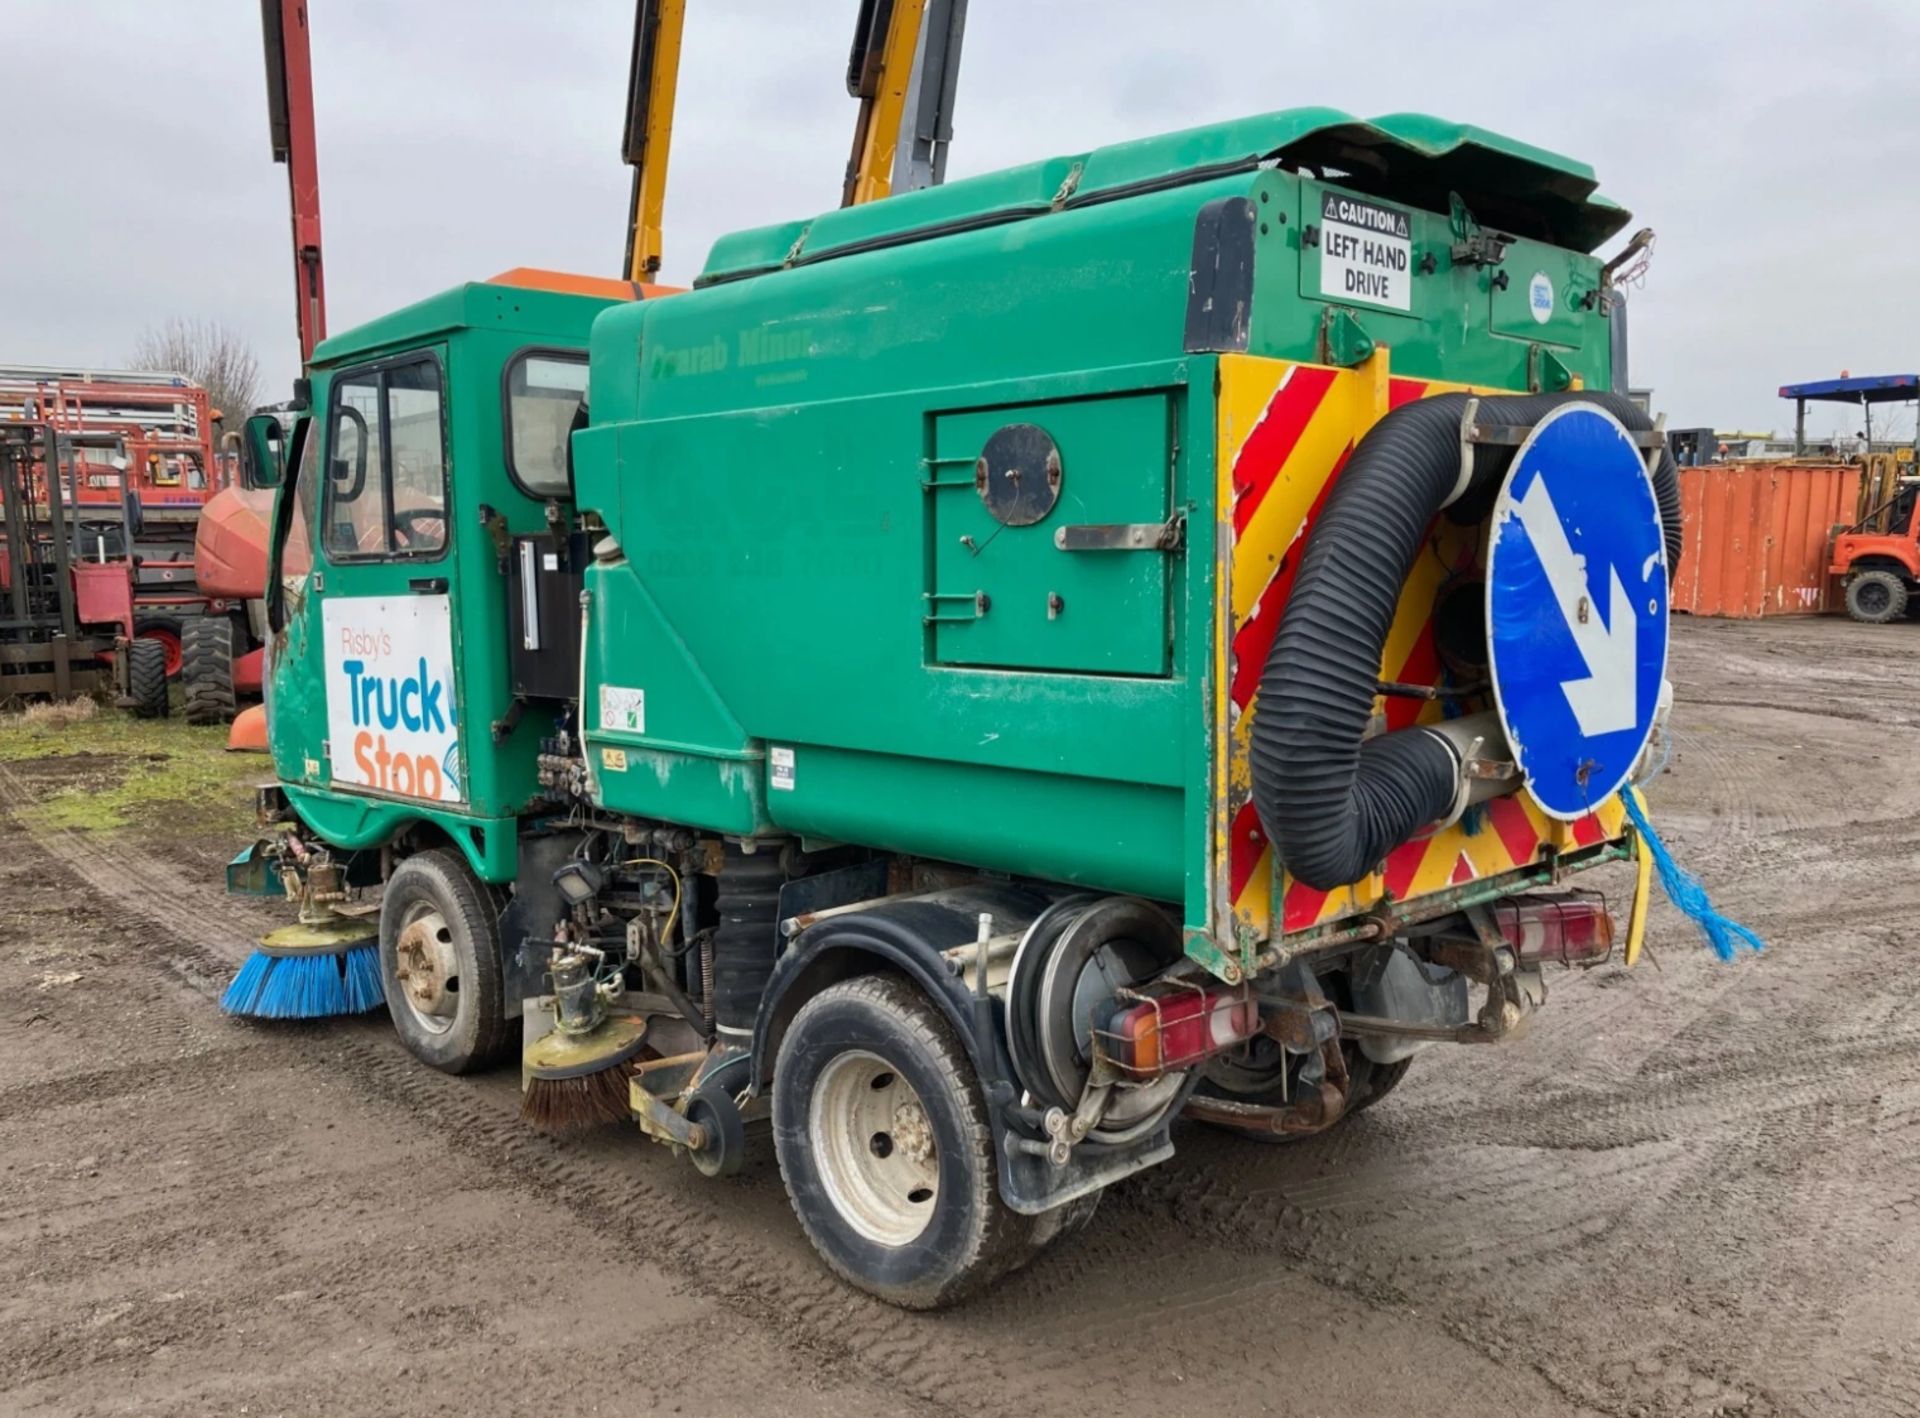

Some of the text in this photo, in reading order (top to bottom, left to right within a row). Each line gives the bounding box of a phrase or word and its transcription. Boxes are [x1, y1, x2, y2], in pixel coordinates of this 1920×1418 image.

[1339, 201, 1396, 233] CAUTION
[1326, 231, 1407, 272] LEFT HAND
[1345, 268, 1389, 299] DRIVE
[341, 627, 391, 661] Risby's
[343, 656, 446, 734] Truck
[354, 731, 442, 801] Stop
